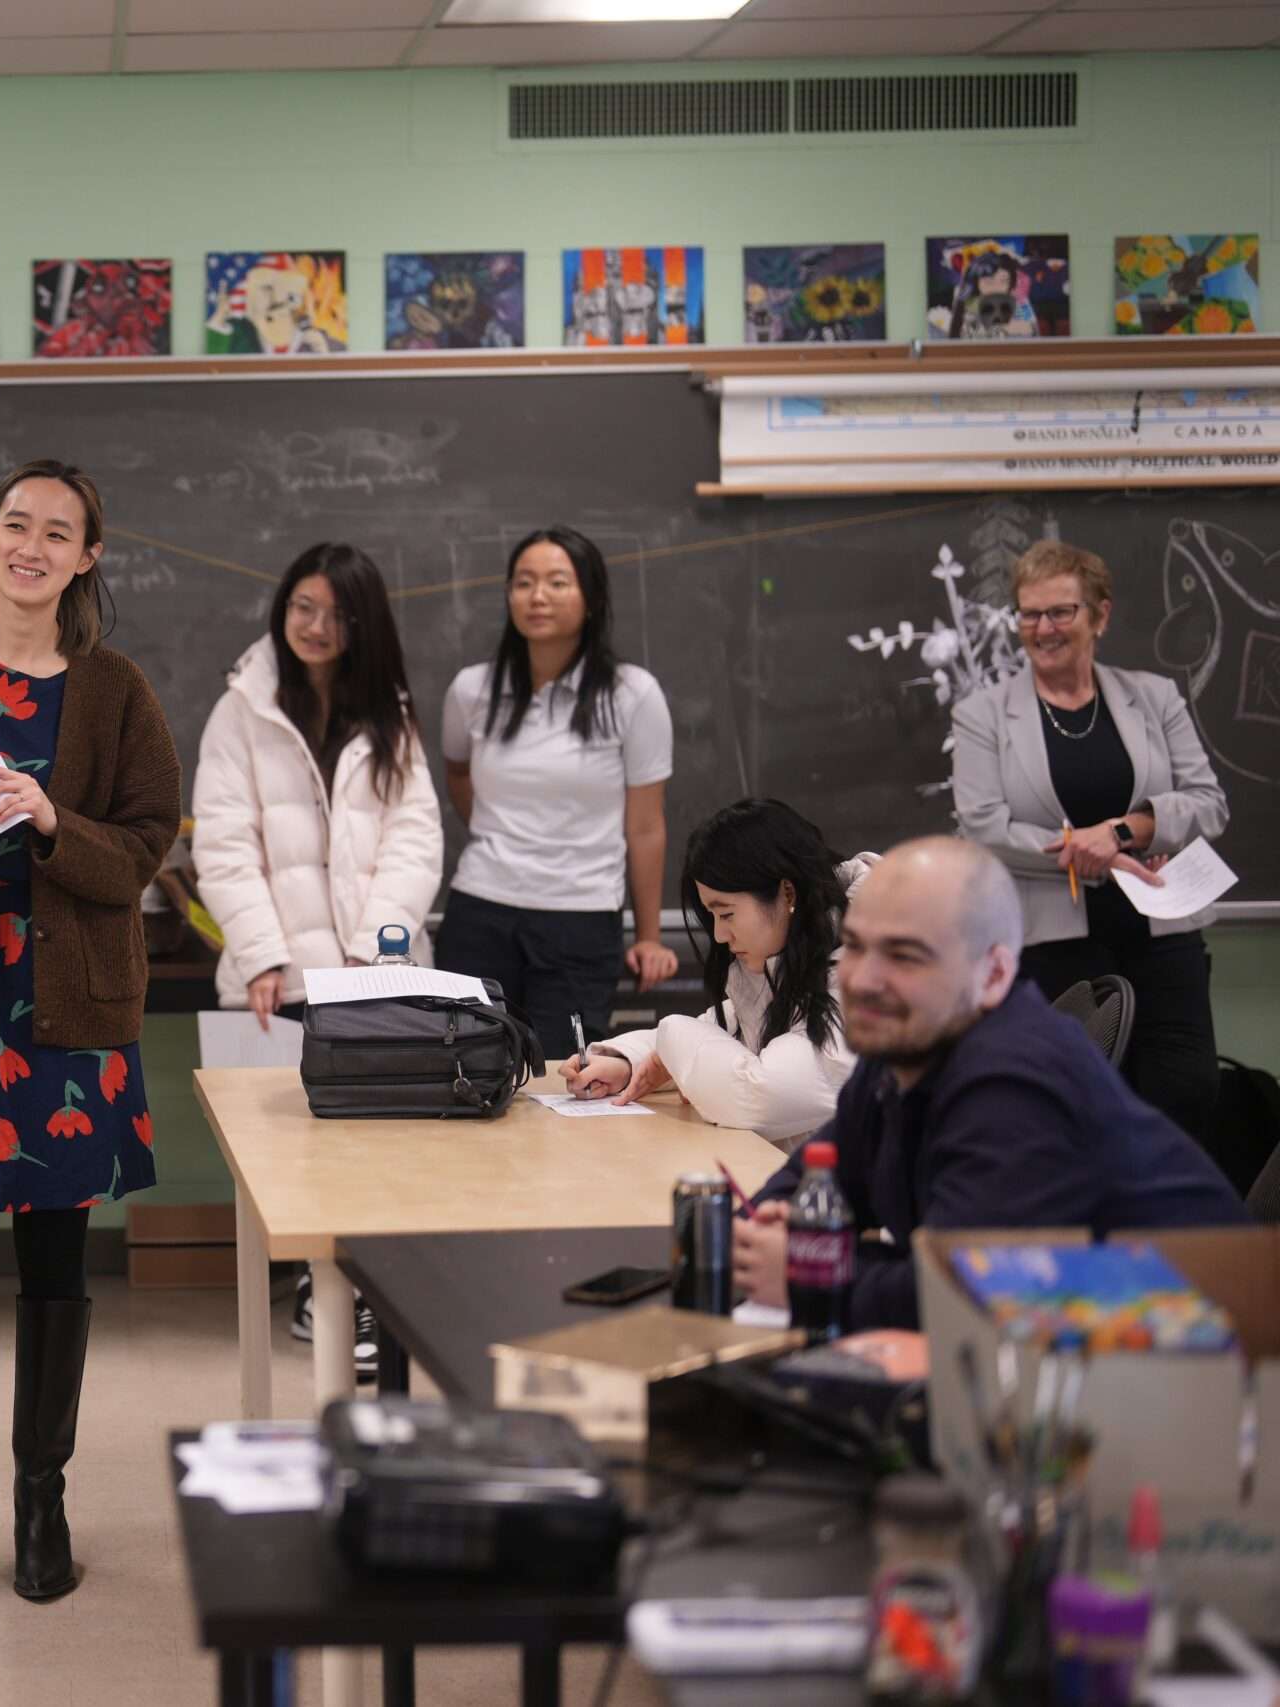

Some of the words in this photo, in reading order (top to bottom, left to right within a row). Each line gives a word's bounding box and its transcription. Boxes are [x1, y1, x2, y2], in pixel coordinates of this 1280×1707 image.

[1173, 423, 1263, 439] CANADA
[1131, 453, 1216, 468] POLITICAL
[1219, 452, 1280, 467] WORLD
